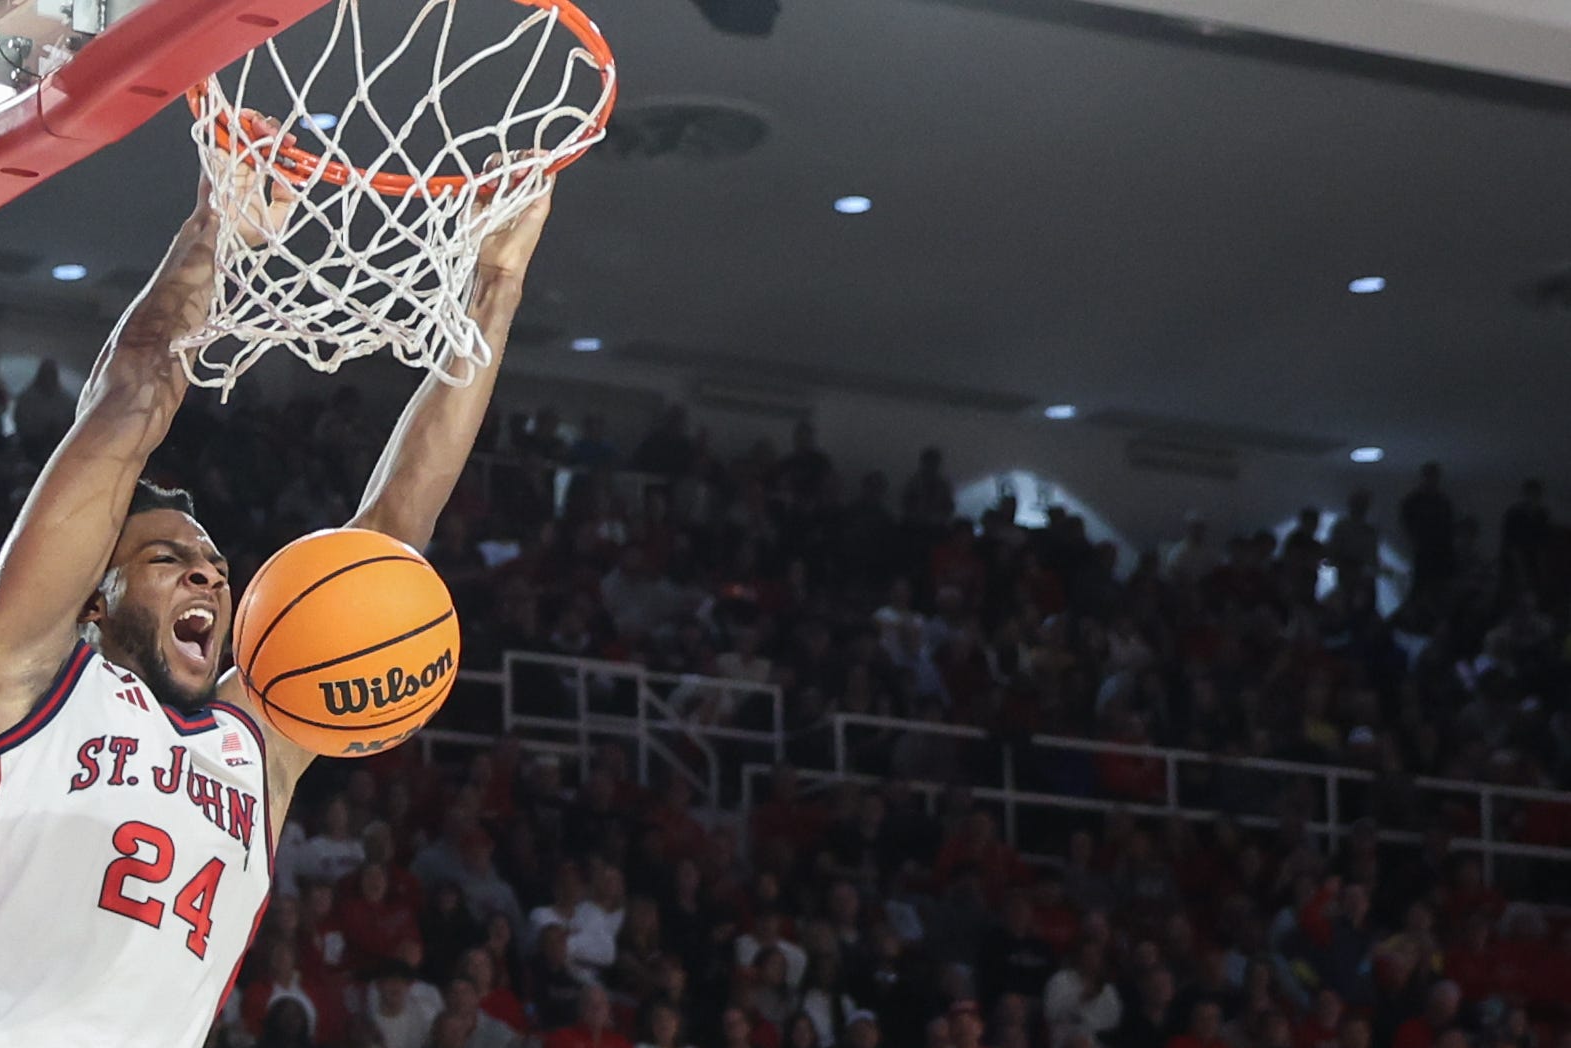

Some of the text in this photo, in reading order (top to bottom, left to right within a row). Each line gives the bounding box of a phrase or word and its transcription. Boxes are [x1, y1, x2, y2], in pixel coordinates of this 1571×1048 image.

[319, 648, 453, 715] Wilson
[68, 735, 260, 853] ST. JOHN
[98, 821, 225, 961] 24
